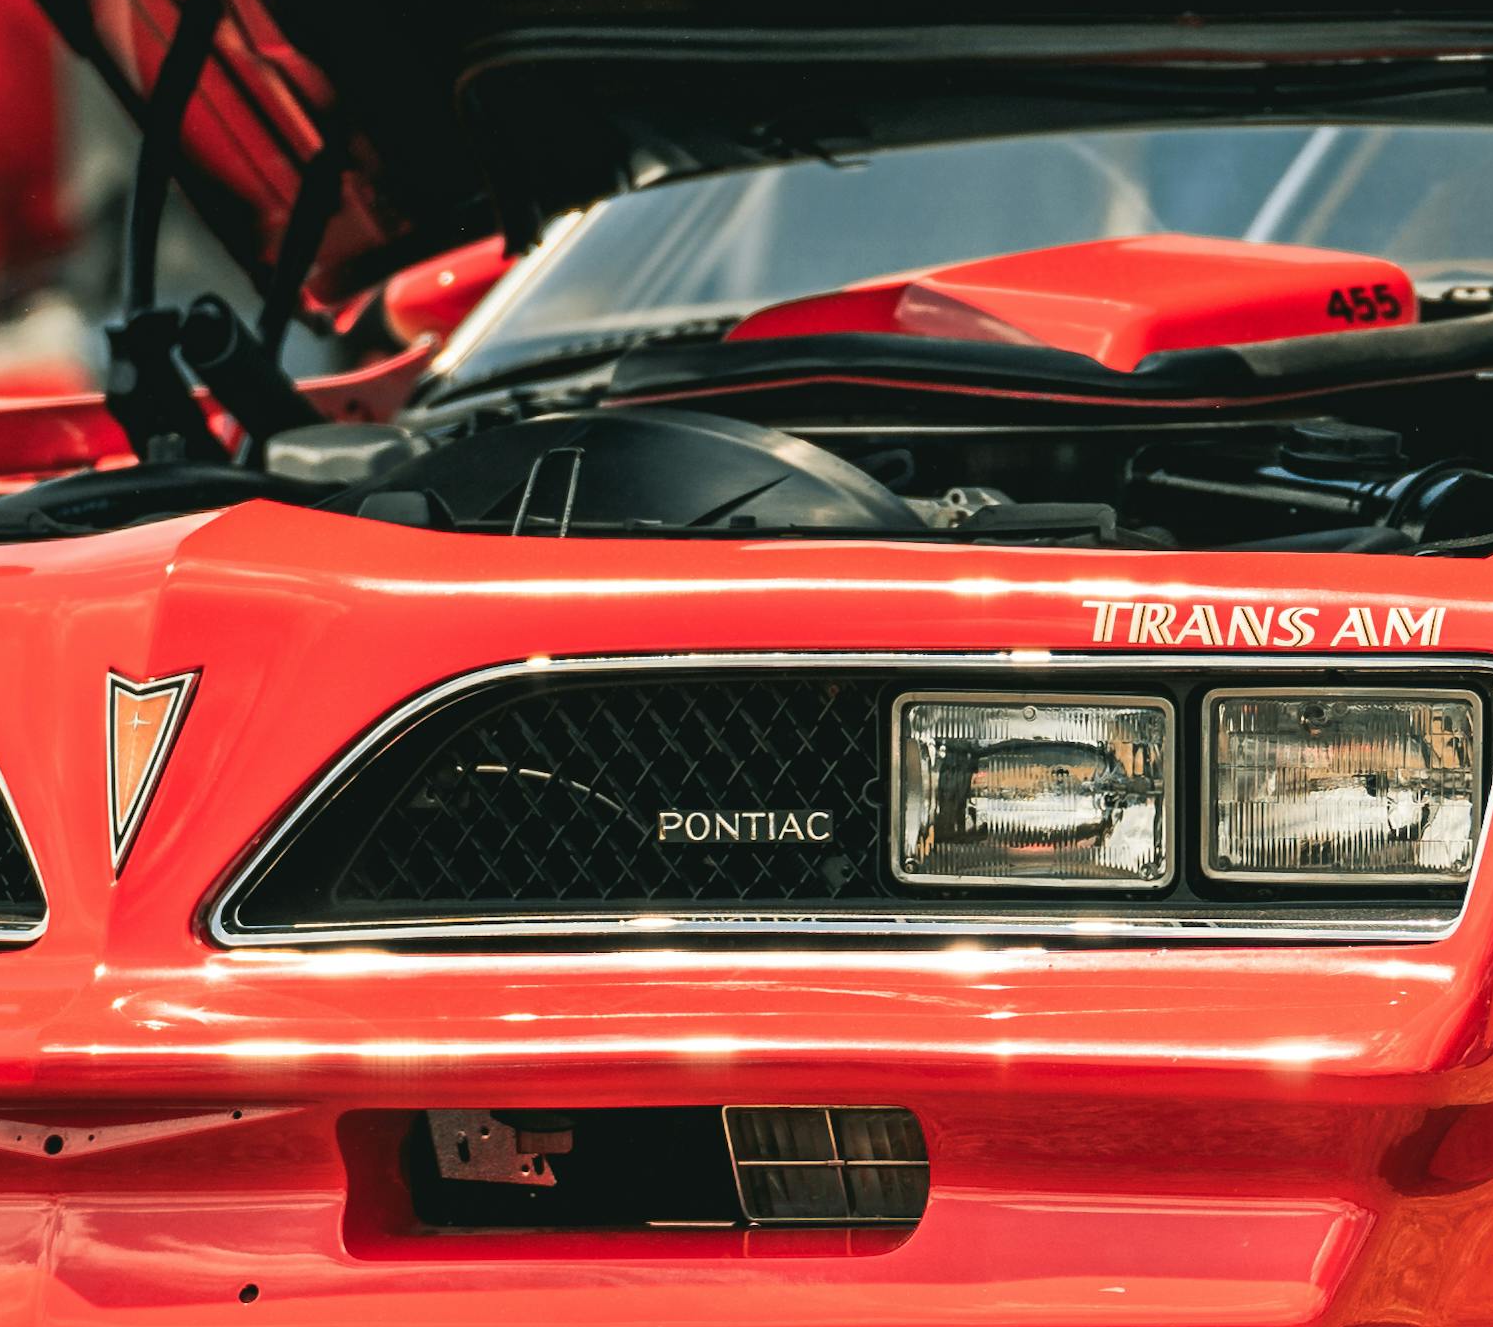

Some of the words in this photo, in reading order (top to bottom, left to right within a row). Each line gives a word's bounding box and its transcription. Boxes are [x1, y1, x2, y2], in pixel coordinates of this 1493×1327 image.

[1327, 284, 1402, 324] 455
[1081, 600, 1320, 648] TRANS
[1329, 606, 1447, 647] AM
[658, 811, 831, 841] PONTIAC
